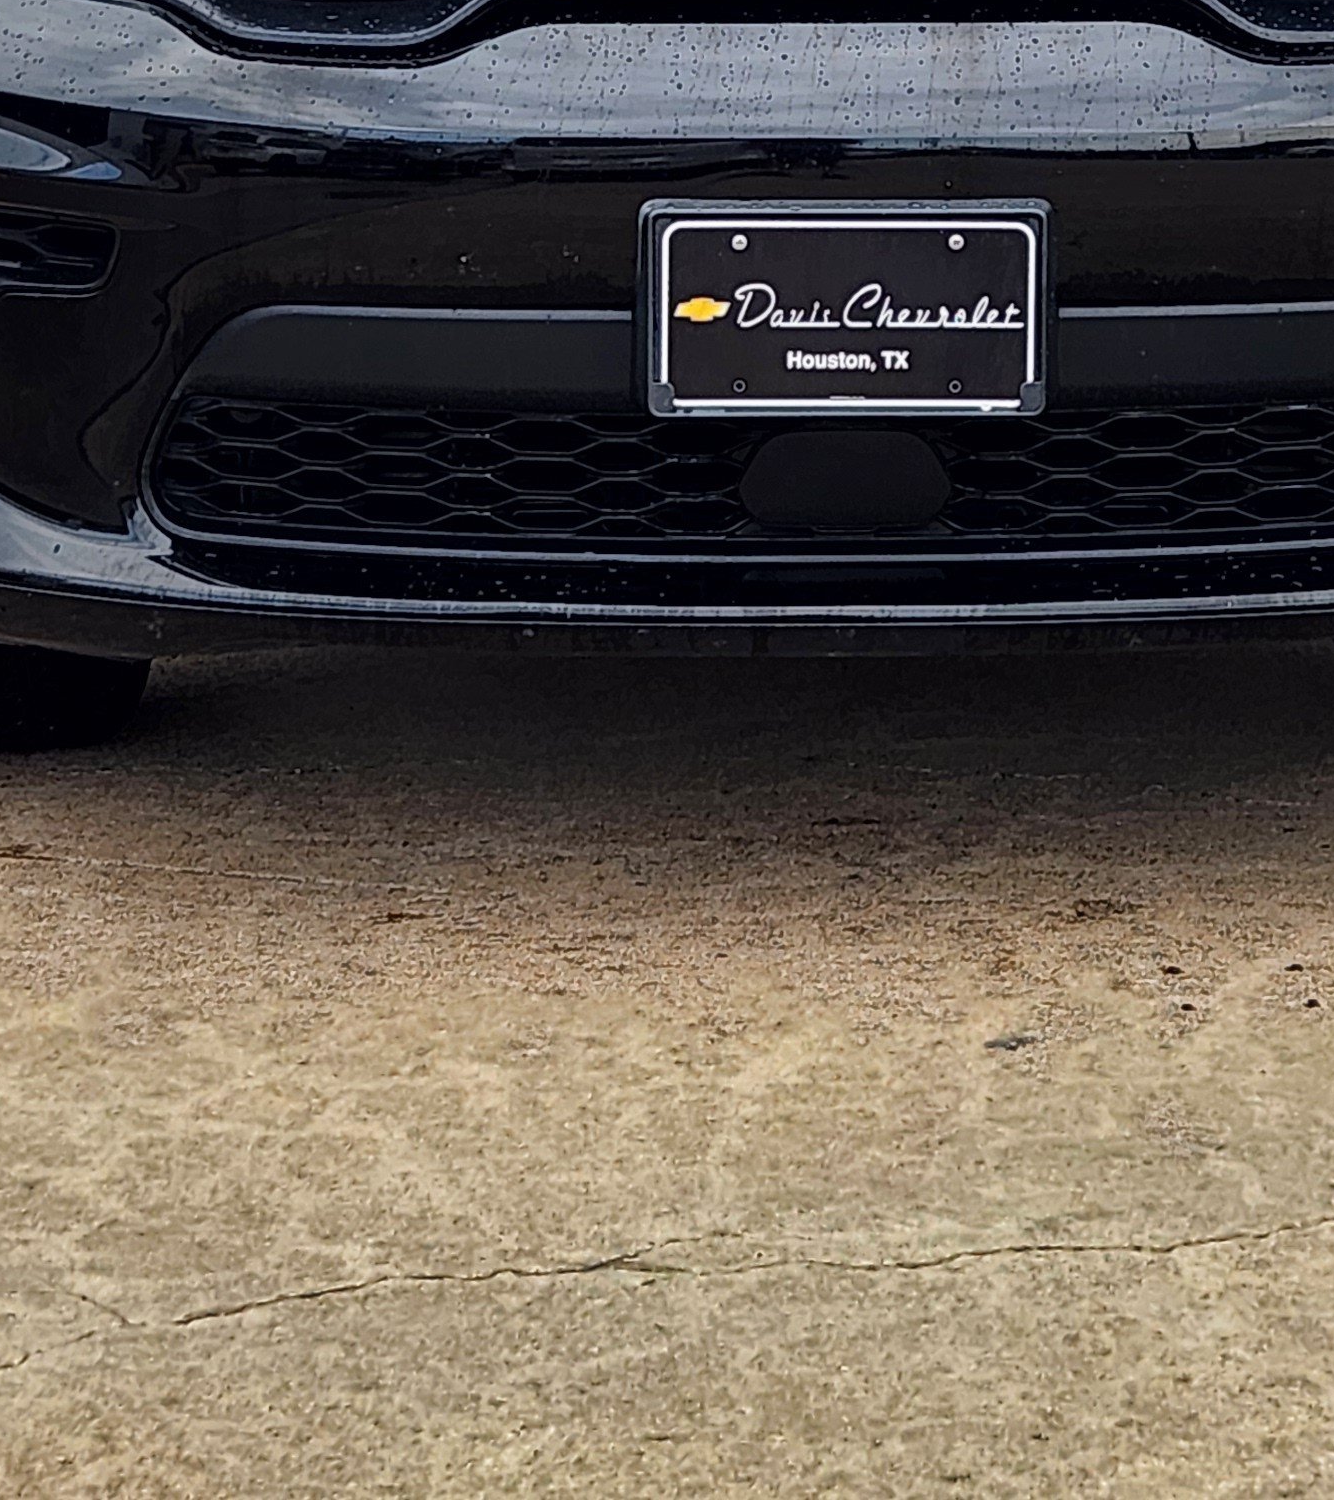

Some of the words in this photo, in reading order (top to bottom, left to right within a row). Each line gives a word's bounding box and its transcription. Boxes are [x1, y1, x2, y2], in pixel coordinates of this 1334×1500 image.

[736, 283, 840, 328] Davis
[843, 283, 1024, 328] Chevrolet
[786, 350, 876, 372] Houston,
[881, 350, 909, 370] TX
